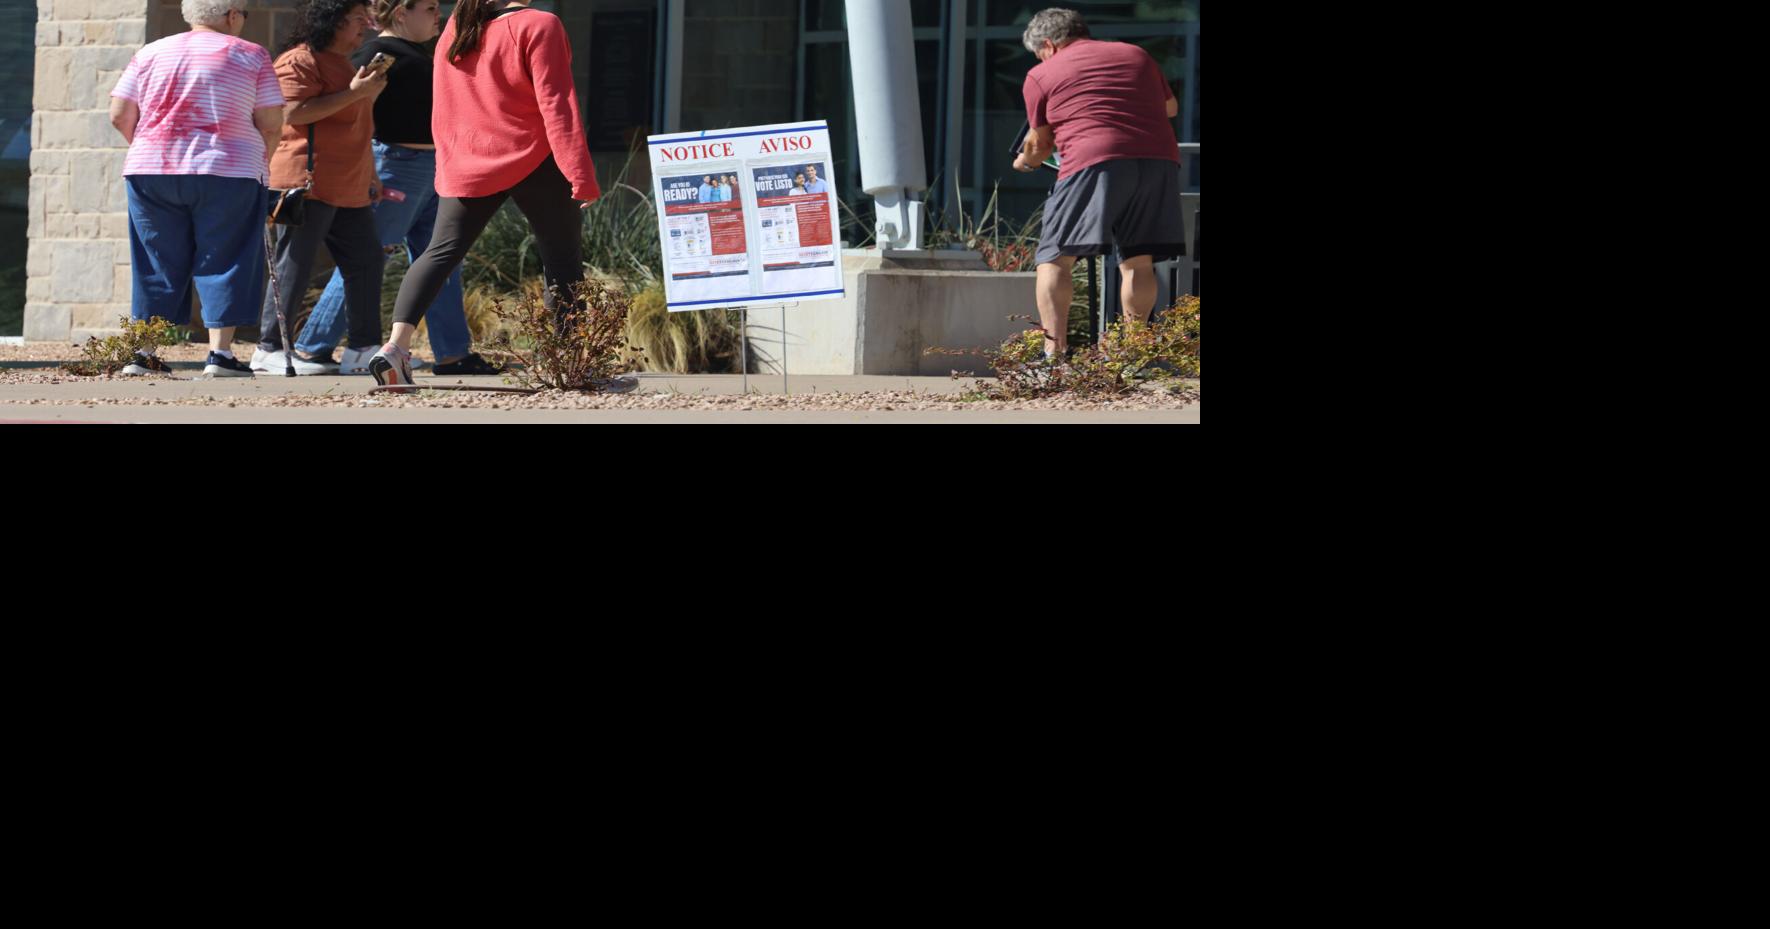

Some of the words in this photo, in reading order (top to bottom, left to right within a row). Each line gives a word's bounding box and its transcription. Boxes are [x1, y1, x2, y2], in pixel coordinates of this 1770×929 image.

[660, 142, 735, 162] NOTICE
[760, 135, 812, 153] AVISO
[755, 180, 774, 192] VOTE
[774, 178, 793, 190] LISTO
[664, 187, 699, 202] READY?
